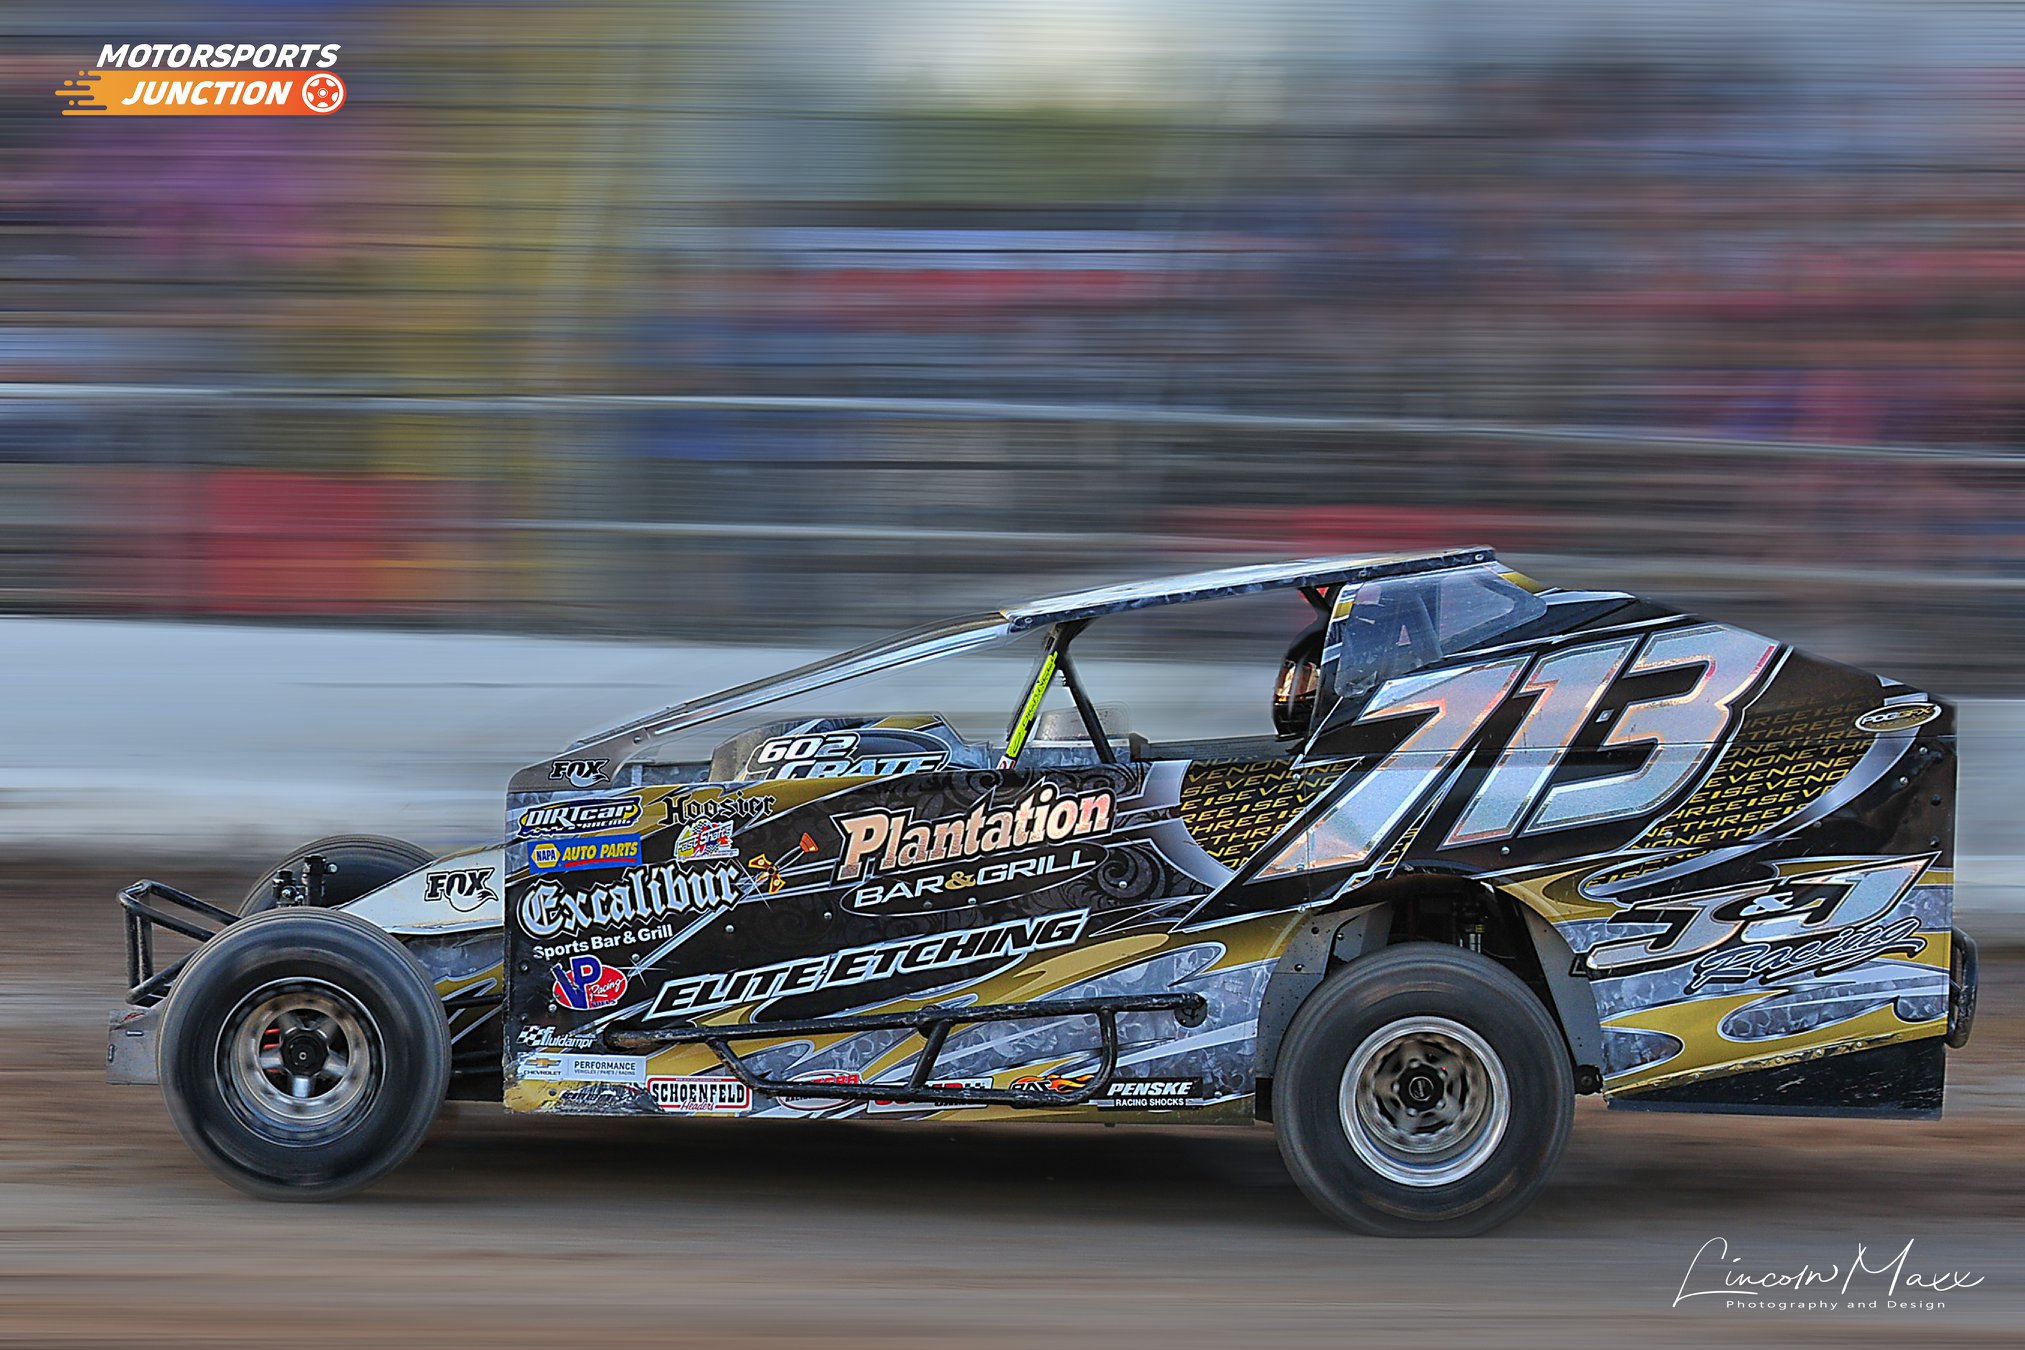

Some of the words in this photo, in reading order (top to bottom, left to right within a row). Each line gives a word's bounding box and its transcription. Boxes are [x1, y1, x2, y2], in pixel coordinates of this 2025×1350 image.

[757, 735, 858, 764] 602
[550, 760, 608, 785] FOX
[525, 804, 633, 828] DIRTcar
[656, 789, 777, 825] Hoosier
[836, 787, 1111, 880] Plantation
[535, 848, 557, 862] NAPA
[562, 845, 597, 861] AUTO
[600, 841, 639, 858] PARTS
[425, 868, 496, 908] FOX
[853, 876, 944, 909] BAR
[944, 869, 977, 890] &
[976, 849, 1097, 885] GRILL
[519, 858, 741, 937] Excalibur
[533, 938, 590, 960] Sports
[590, 934, 622, 951] Bar
[622, 931, 637, 945] &
[637, 924, 674, 944] Grill
[1686, 918, 1928, 993] Racing
[648, 958, 827, 1018] ELITE
[828, 912, 1089, 987] ETCHING
[551, 956, 602, 1008] VP
[590, 977, 625, 1000] Racing
[523, 1069, 561, 1077] CHEVROLET
[574, 1060, 636, 1071] PERFORMANCE
[651, 1082, 745, 1103] SCHOENFELD
[1107, 1081, 1193, 1096] PENSKE
[680, 1099, 716, 1111] Headers
[1115, 1098, 1148, 1107] RACING
[1149, 1098, 1184, 1106] SHOCKS
